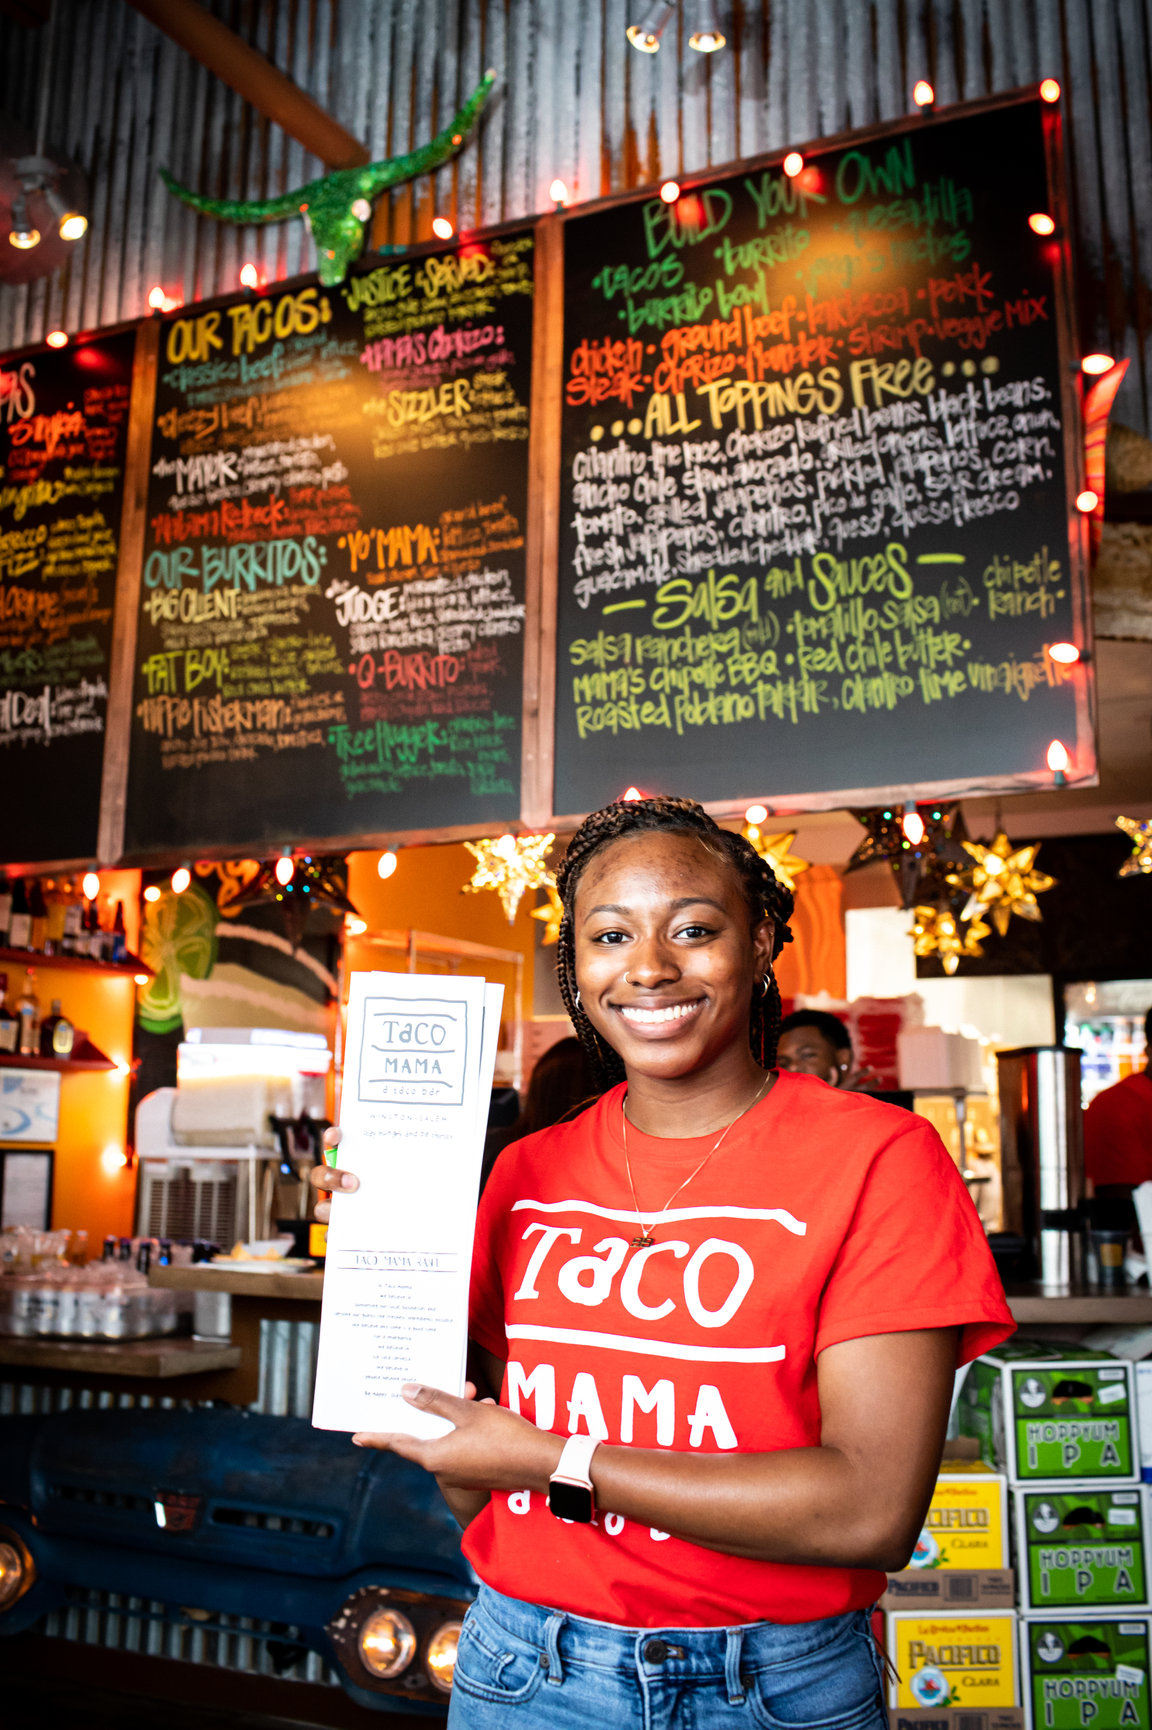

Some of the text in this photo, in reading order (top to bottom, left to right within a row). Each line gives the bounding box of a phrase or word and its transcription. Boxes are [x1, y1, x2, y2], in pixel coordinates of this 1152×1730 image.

[642, 188, 733, 259] BUILD
[835, 138, 915, 205] OWN
[601, 252, 685, 299] tacos
[167, 311, 224, 365] OUR
[696, 366, 844, 431] TOPPINGS
[144, 546, 201, 590] OUR
[726, 649, 781, 687] BBQ
[384, 1057, 443, 1075] MAMA
[506, 1360, 739, 1450] MAMA
[924, 1507, 990, 1528] CIFICO
[908, 1640, 1002, 1670] PACIFICO
